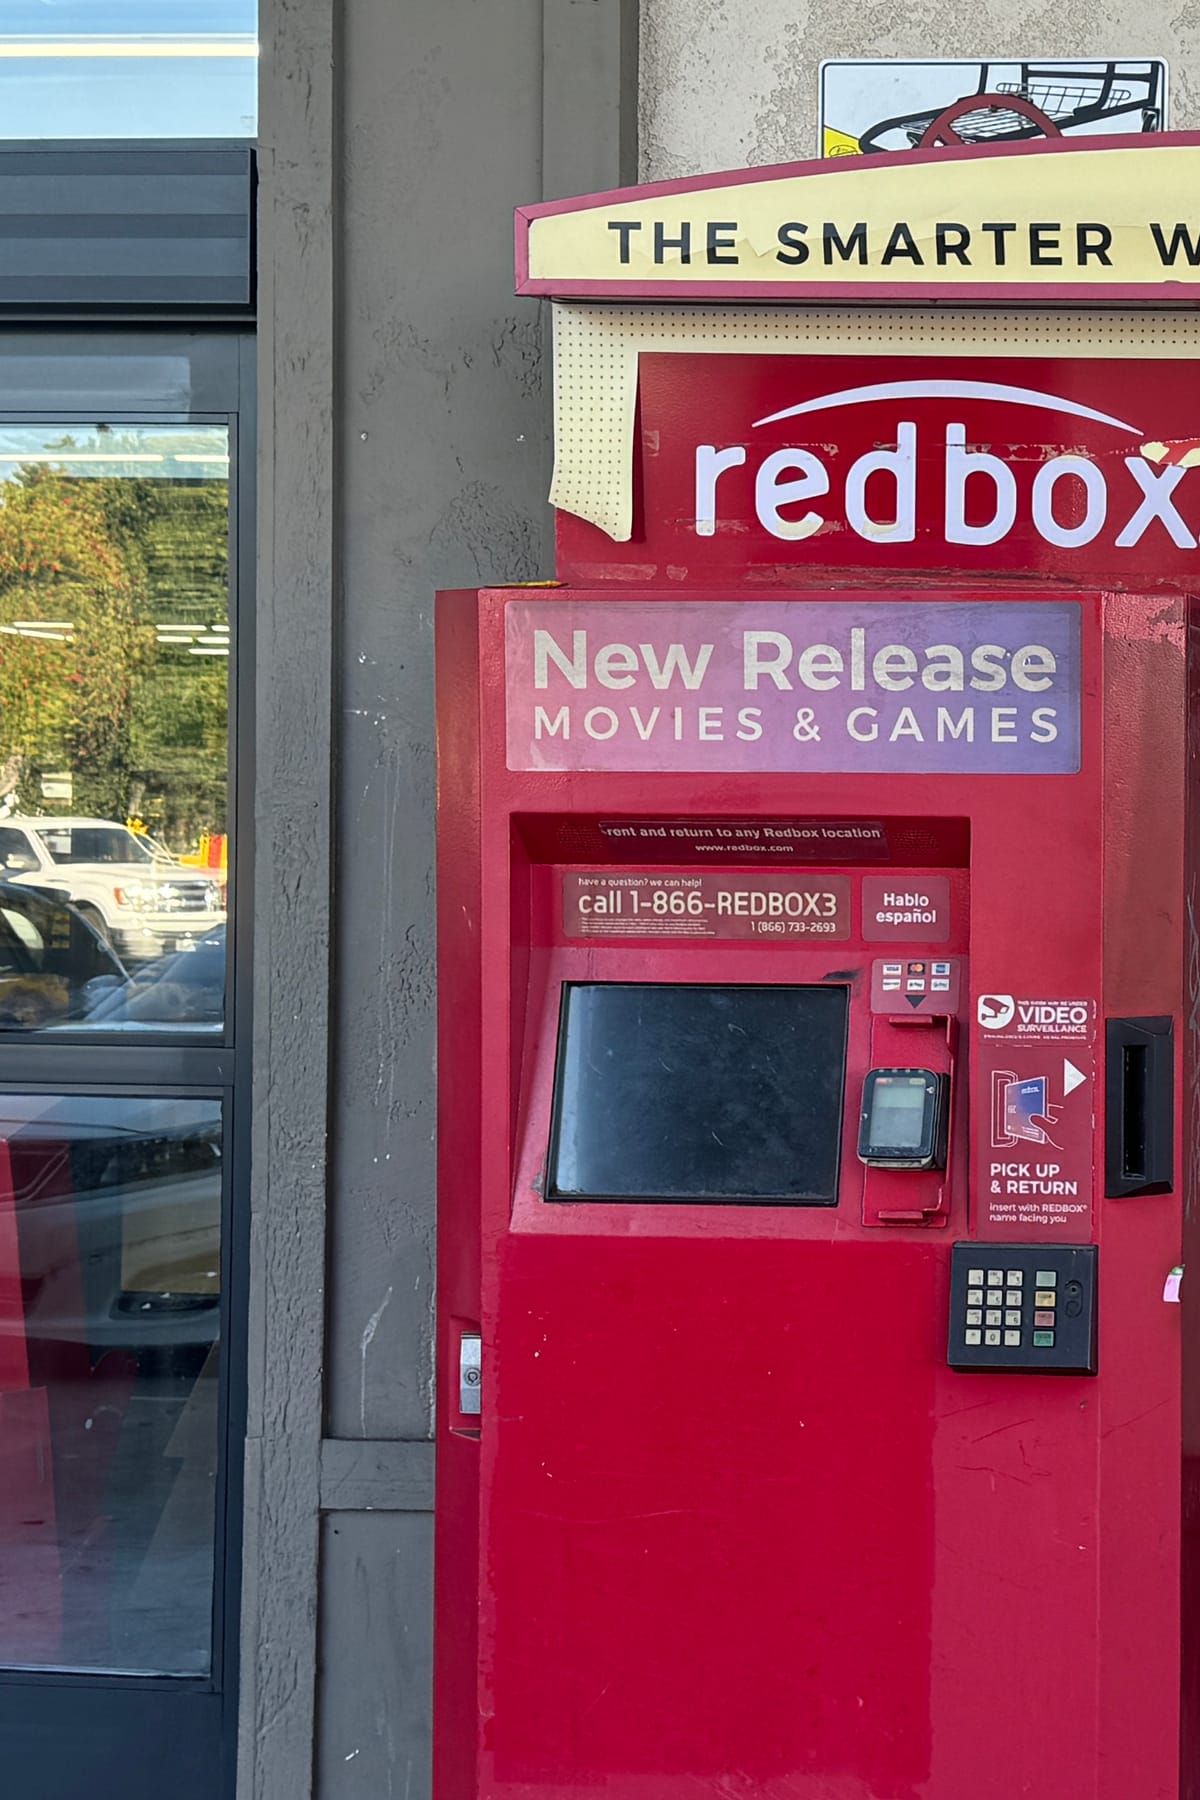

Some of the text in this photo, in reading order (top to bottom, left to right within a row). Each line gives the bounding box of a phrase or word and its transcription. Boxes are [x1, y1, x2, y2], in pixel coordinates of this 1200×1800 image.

[607, 221, 740, 266] THE
[776, 221, 1112, 267] SMARTER
[534, 628, 1057, 692] New Release
[534, 706, 1058, 743] MOVIES & GAMES
[640, 827, 666, 837] and
[670, 828, 713, 837] return
[716, 828, 732, 837] to
[735, 829, 760, 840] any
[764, 827, 819, 838] Redbox
[822, 827, 881, 839] location
[695, 844, 794, 852] www.redbox.com
[578, 878, 599, 886] have
[608, 878, 649, 887] question?
[681, 879, 702, 888] help!
[578, 890, 837, 917] call 1-866-REDBOX3
[883, 893, 930, 907] Hablo
[875, 908, 937, 925] español
[750, 921, 837, 934] 1 (866) 733-2693
[1018, 1006, 1088, 1024] VIDEO
[1017, 1024, 1087, 1033] SURVEILLANCE
[990, 1163, 1060, 1178] PICK UP
[990, 1180, 1077, 1195] & RETURN
[989, 1203, 1016, 1212] insert
[1017, 1203, 1040, 1212] with
[989, 1213, 1067, 1224] name facing you
